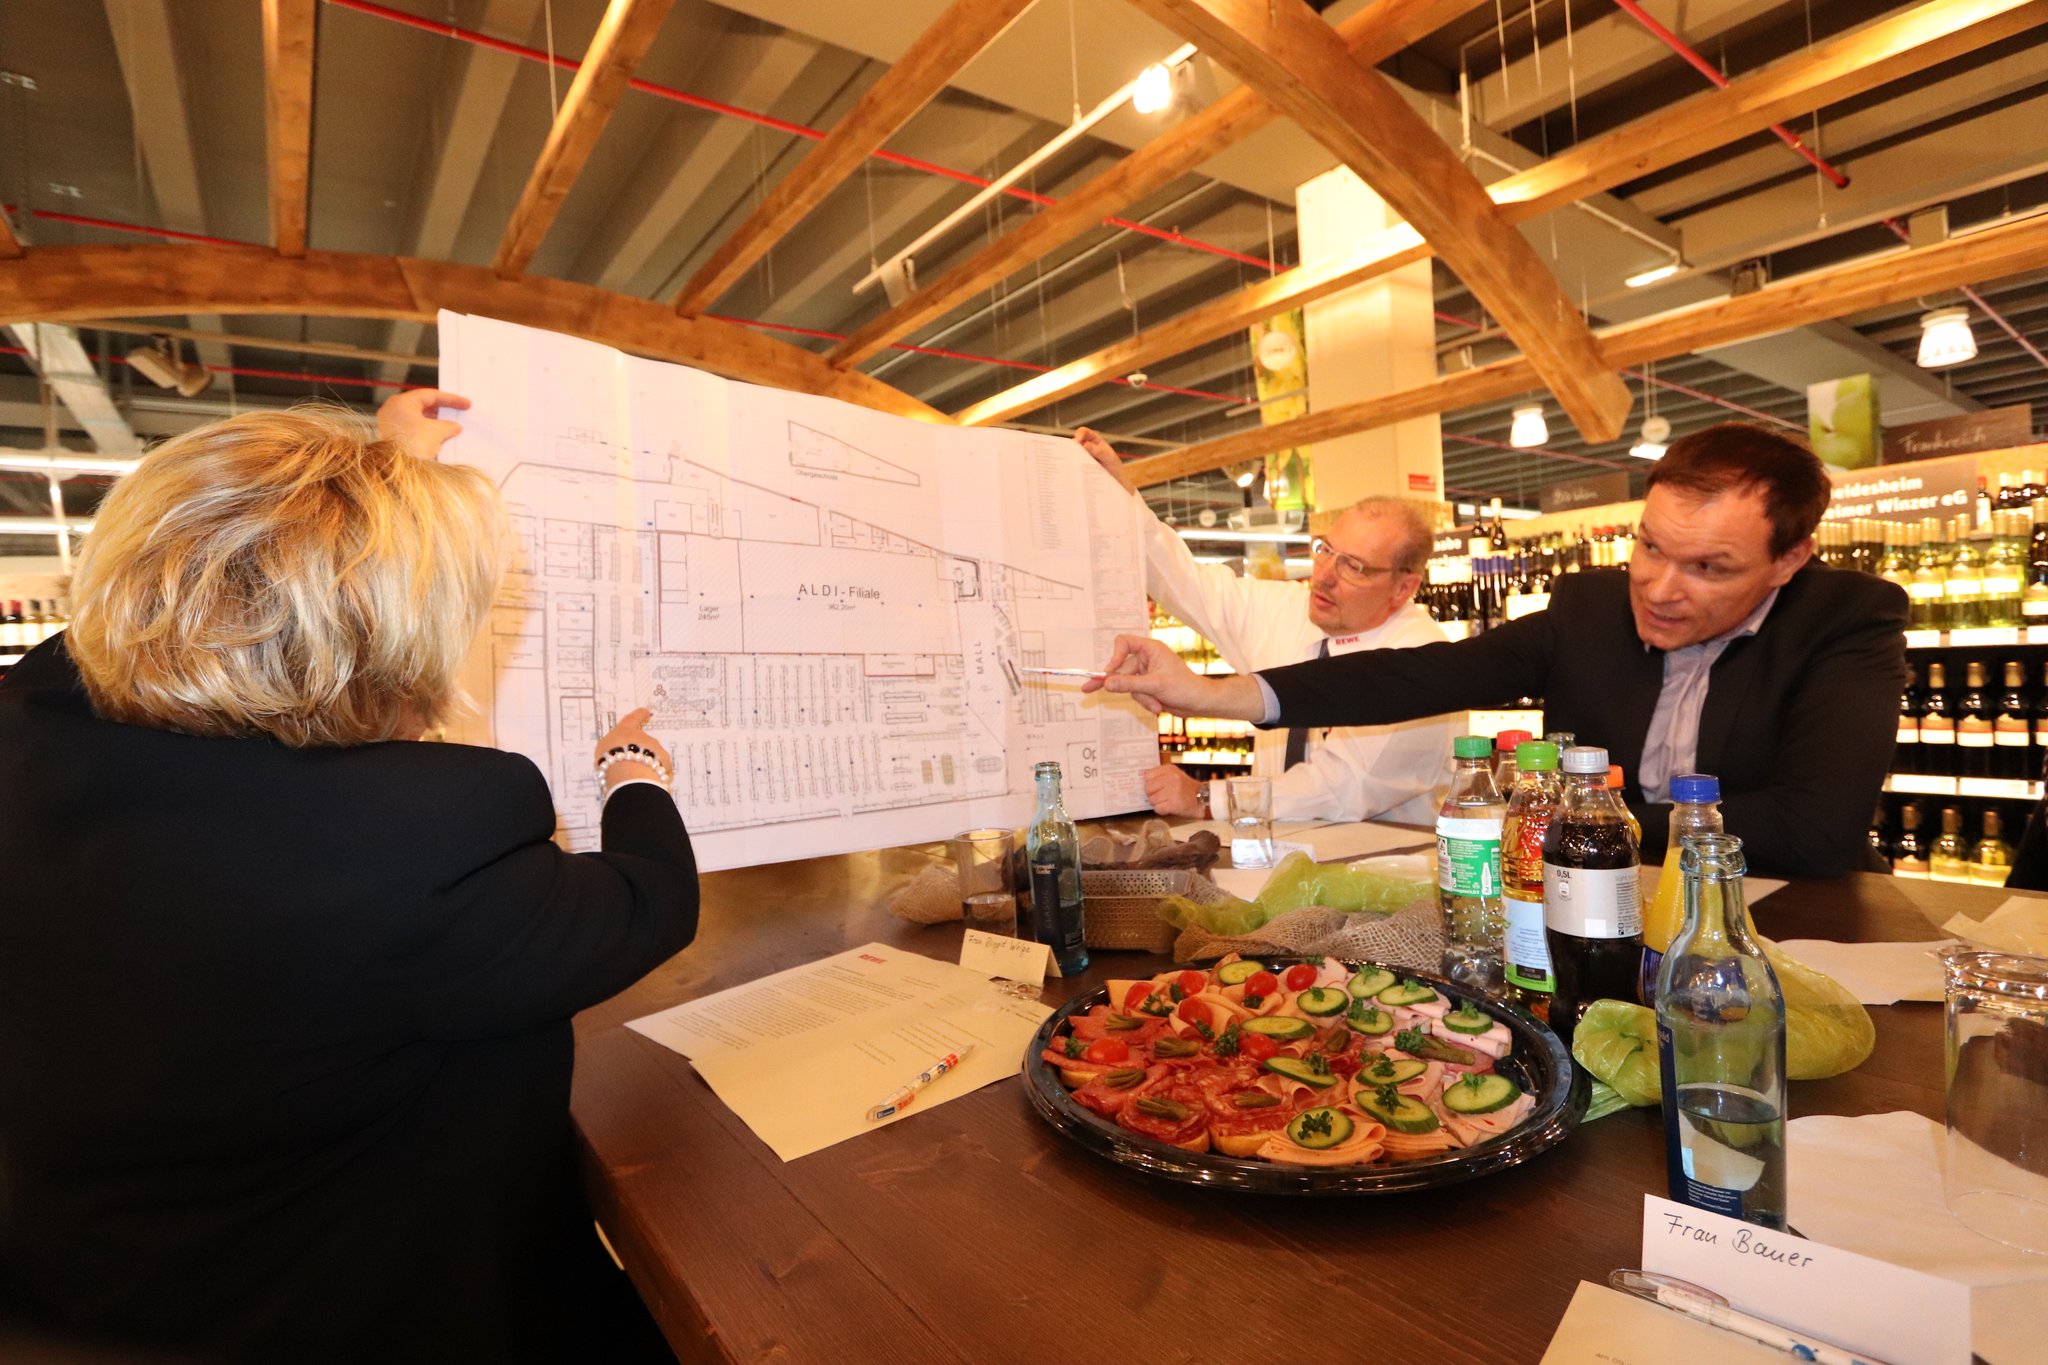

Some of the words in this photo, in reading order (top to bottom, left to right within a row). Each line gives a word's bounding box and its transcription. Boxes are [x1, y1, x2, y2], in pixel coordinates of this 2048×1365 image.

[1822, 503, 1874, 520] eimer
[1876, 497, 1939, 514] Winzer
[1941, 489, 1968, 507] eG
[848, 586, 880, 600] Filiale
[699, 605, 719, 614] Lager
[1335, 636, 1360, 646] REWE
[973, 641, 984, 675] MALL
[1663, 1212, 1717, 1245] Frau
[1732, 1228, 1813, 1268] Bauer
